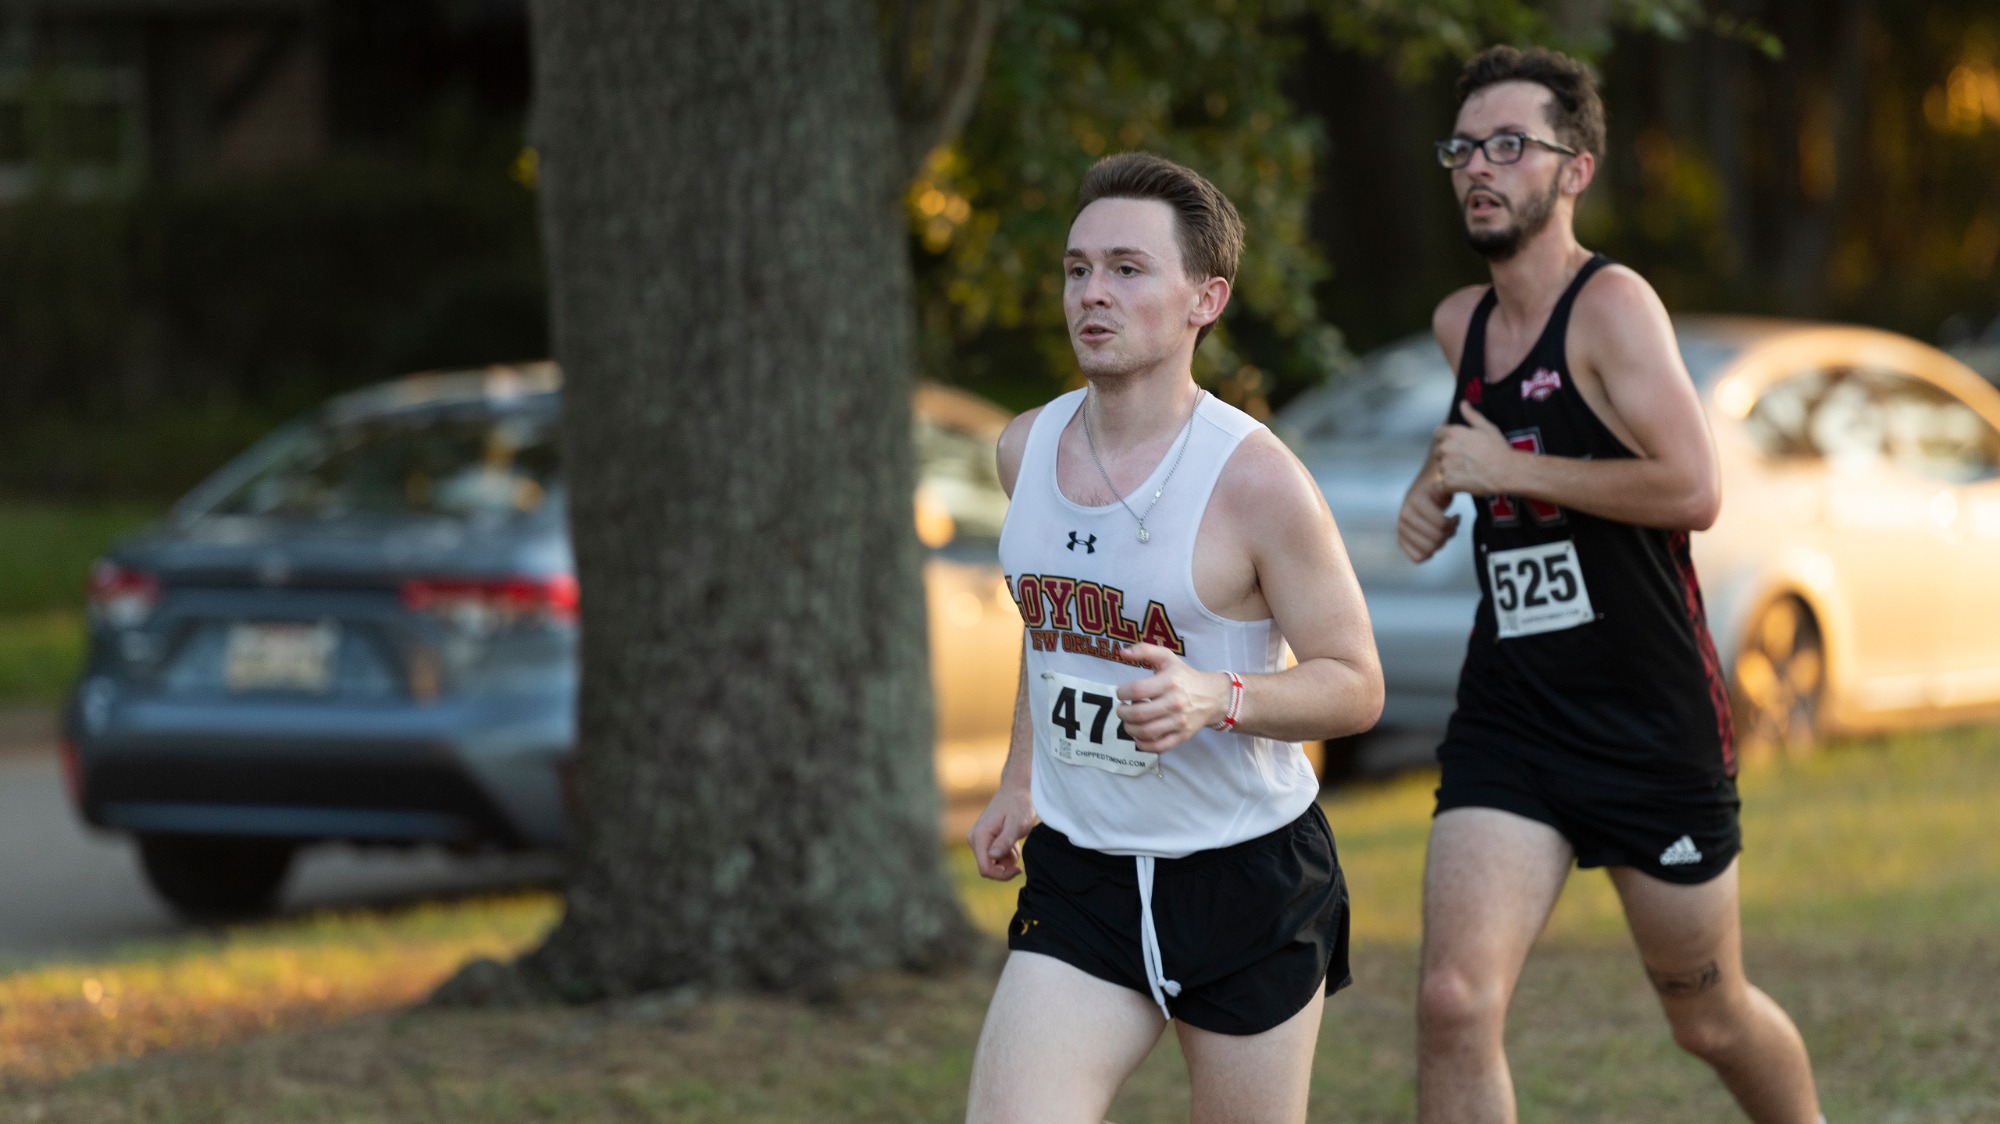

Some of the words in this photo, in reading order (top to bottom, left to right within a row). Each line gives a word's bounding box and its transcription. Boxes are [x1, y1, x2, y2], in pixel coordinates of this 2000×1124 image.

[1494, 553, 1578, 612] 525
[1004, 573, 1186, 656] OYOLA
[1029, 629, 1059, 652] EW
[1061, 631, 1153, 670] ORLEA
